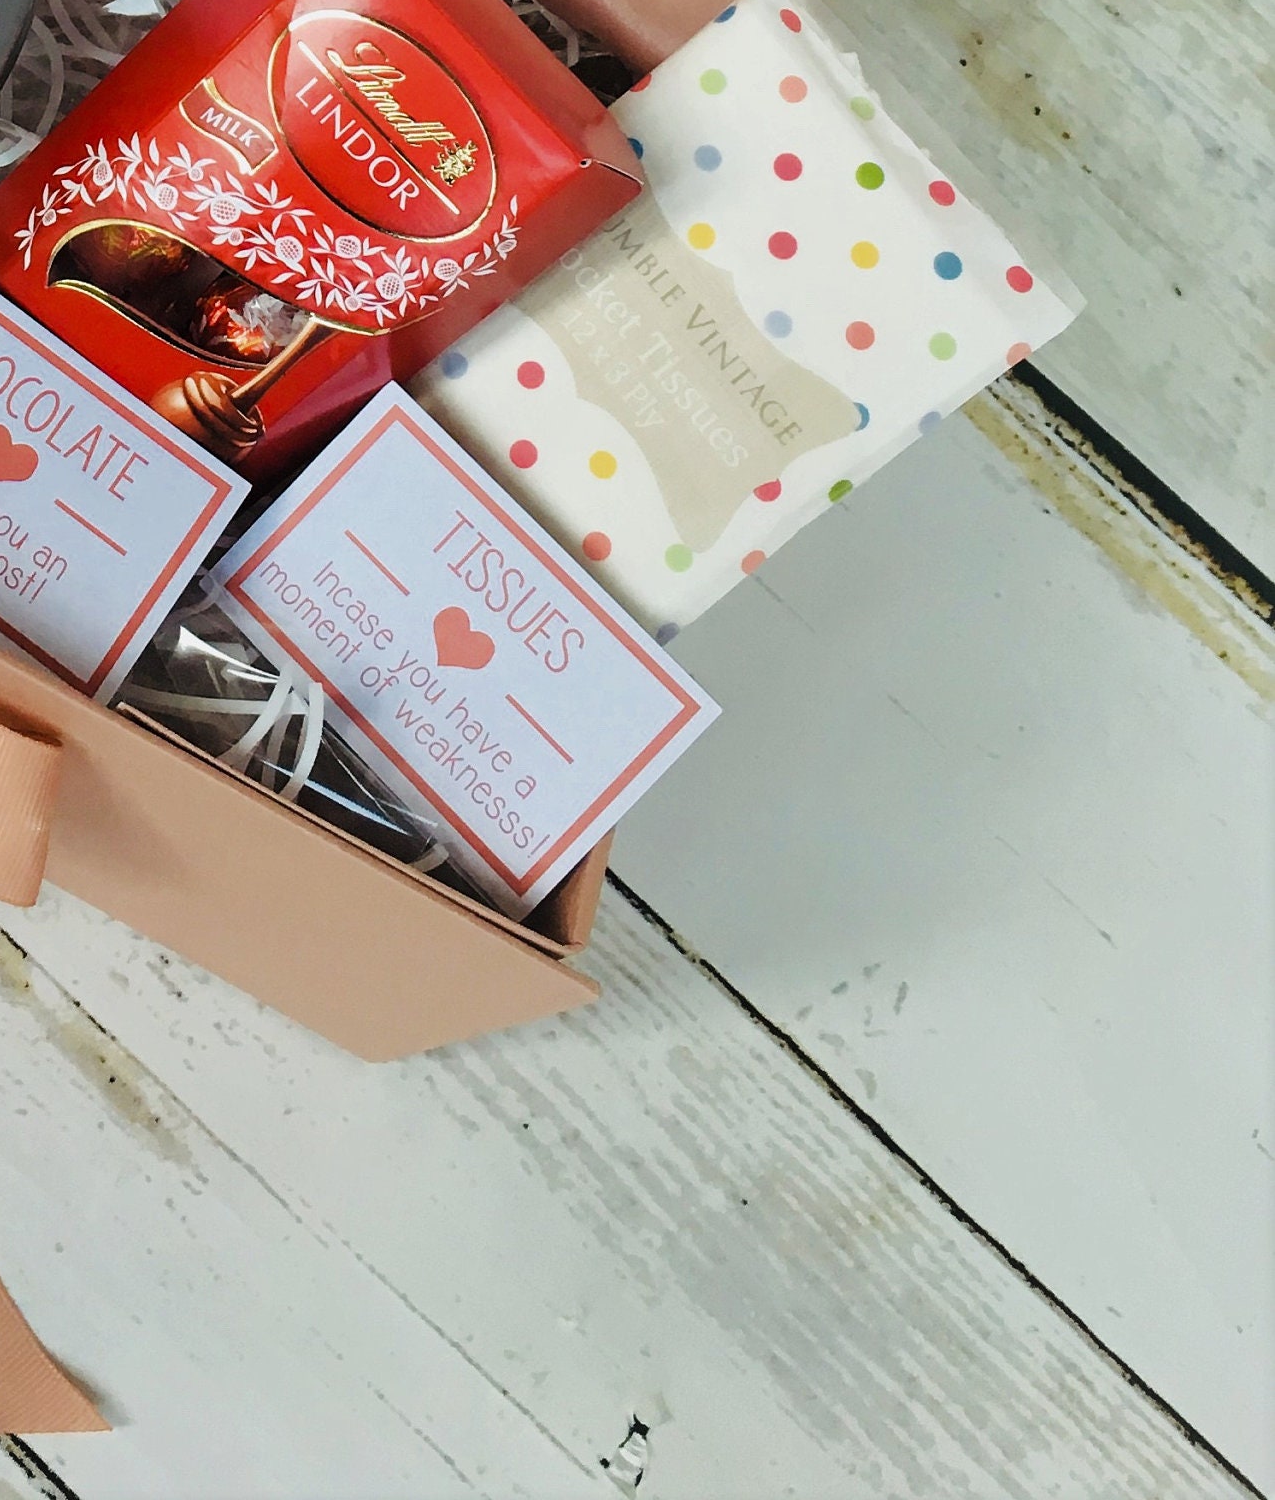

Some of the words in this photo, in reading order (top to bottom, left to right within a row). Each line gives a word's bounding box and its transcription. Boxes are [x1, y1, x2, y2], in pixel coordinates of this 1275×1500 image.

[200, 106, 260, 148] MILK
[295, 76, 420, 211] LINDOR
[326, 42, 456, 147] Lindt
[560, 247, 641, 338] ocket
[637, 331, 749, 468] Tissues
[561, 308, 596, 344] 12
[589, 346, 610, 366] x
[606, 363, 630, 384] 3
[626, 382, 665, 428] Ply
[603, 219, 686, 307] UMBLE
[686, 303, 803, 446] VINTAGE
[33, 546, 67, 581] an
[433, 510, 584, 673] TISSUES
[259, 561, 363, 663] moment
[360, 665, 399, 698] of
[395, 699, 551, 859] weaknesss!
[313, 561, 395, 651] Incase
[387, 650, 447, 706] you
[445, 697, 513, 772] have
[515, 774, 536, 800] a
